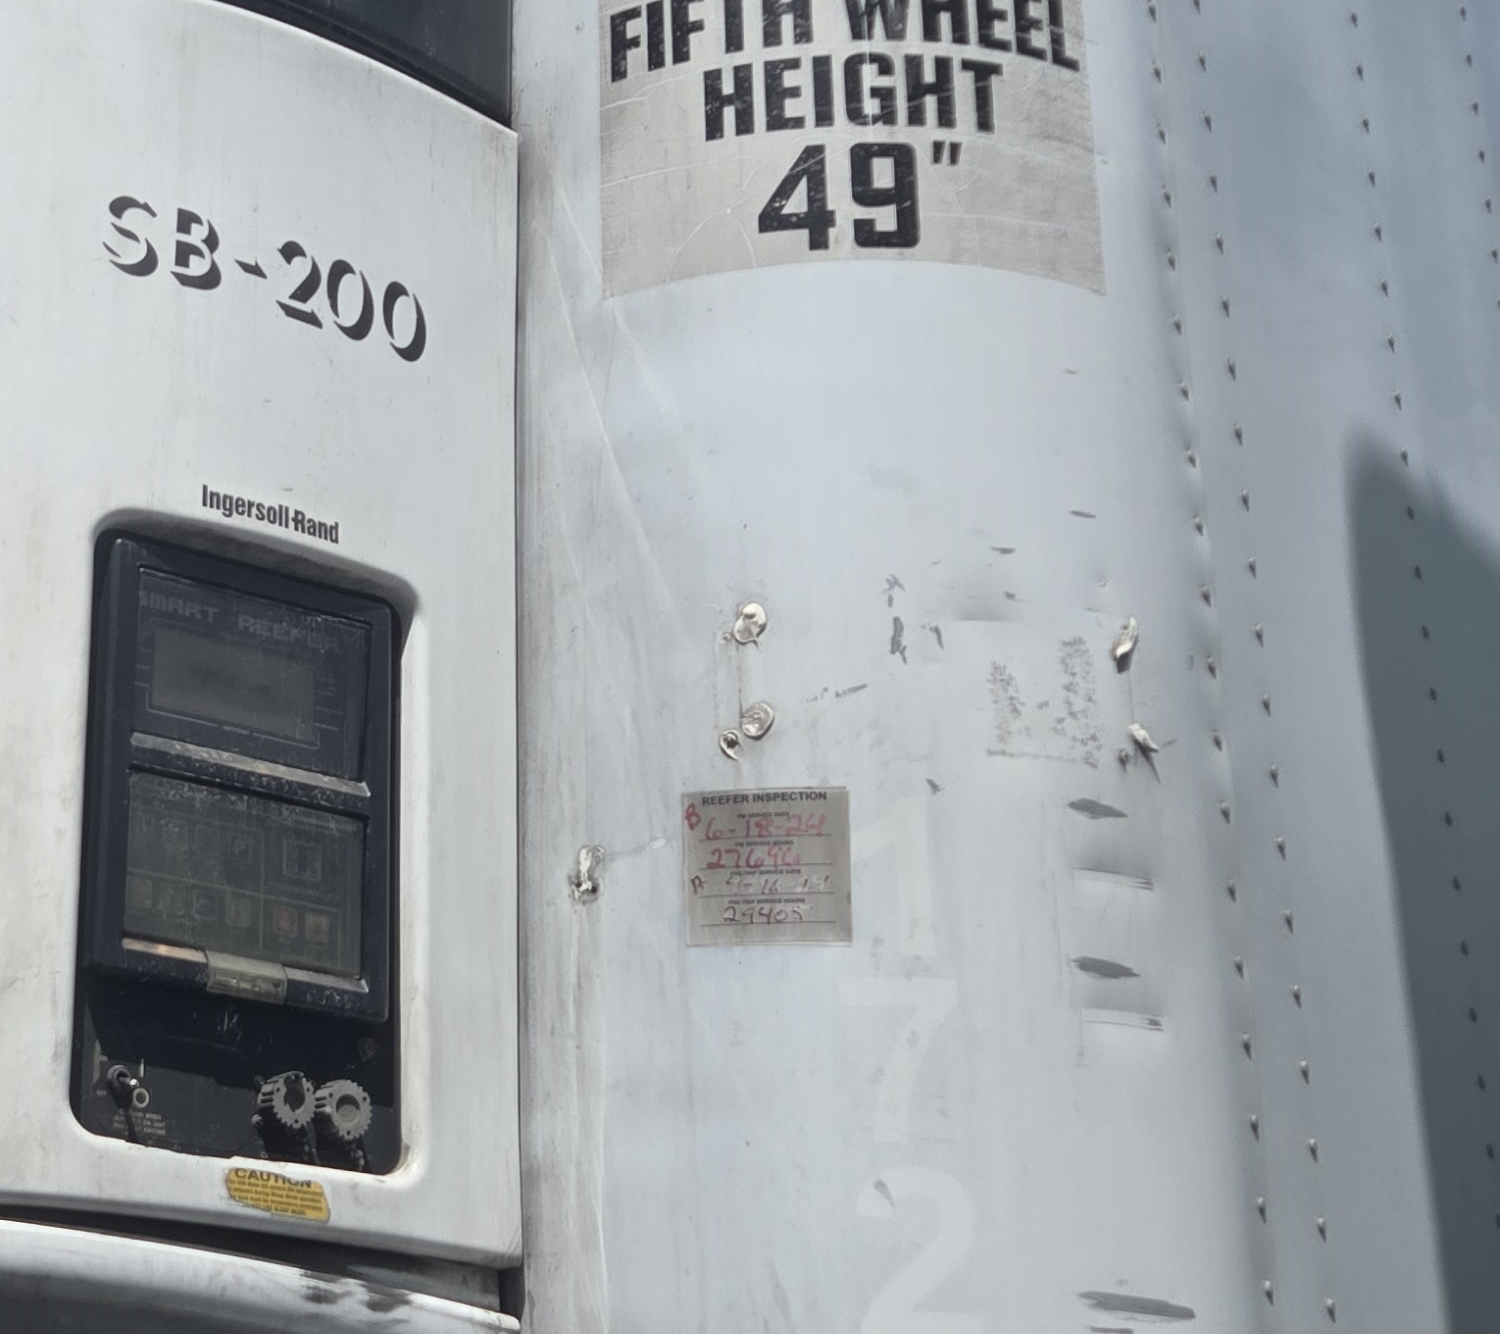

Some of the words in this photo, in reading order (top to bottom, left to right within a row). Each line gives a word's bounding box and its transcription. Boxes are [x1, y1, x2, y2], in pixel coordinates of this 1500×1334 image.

[703, 51, 1004, 142] HEIGHT
[102, 195, 427, 362] SB-200
[702, 793, 749, 807] REEFER
[752, 790, 828, 804] INSPECTION
